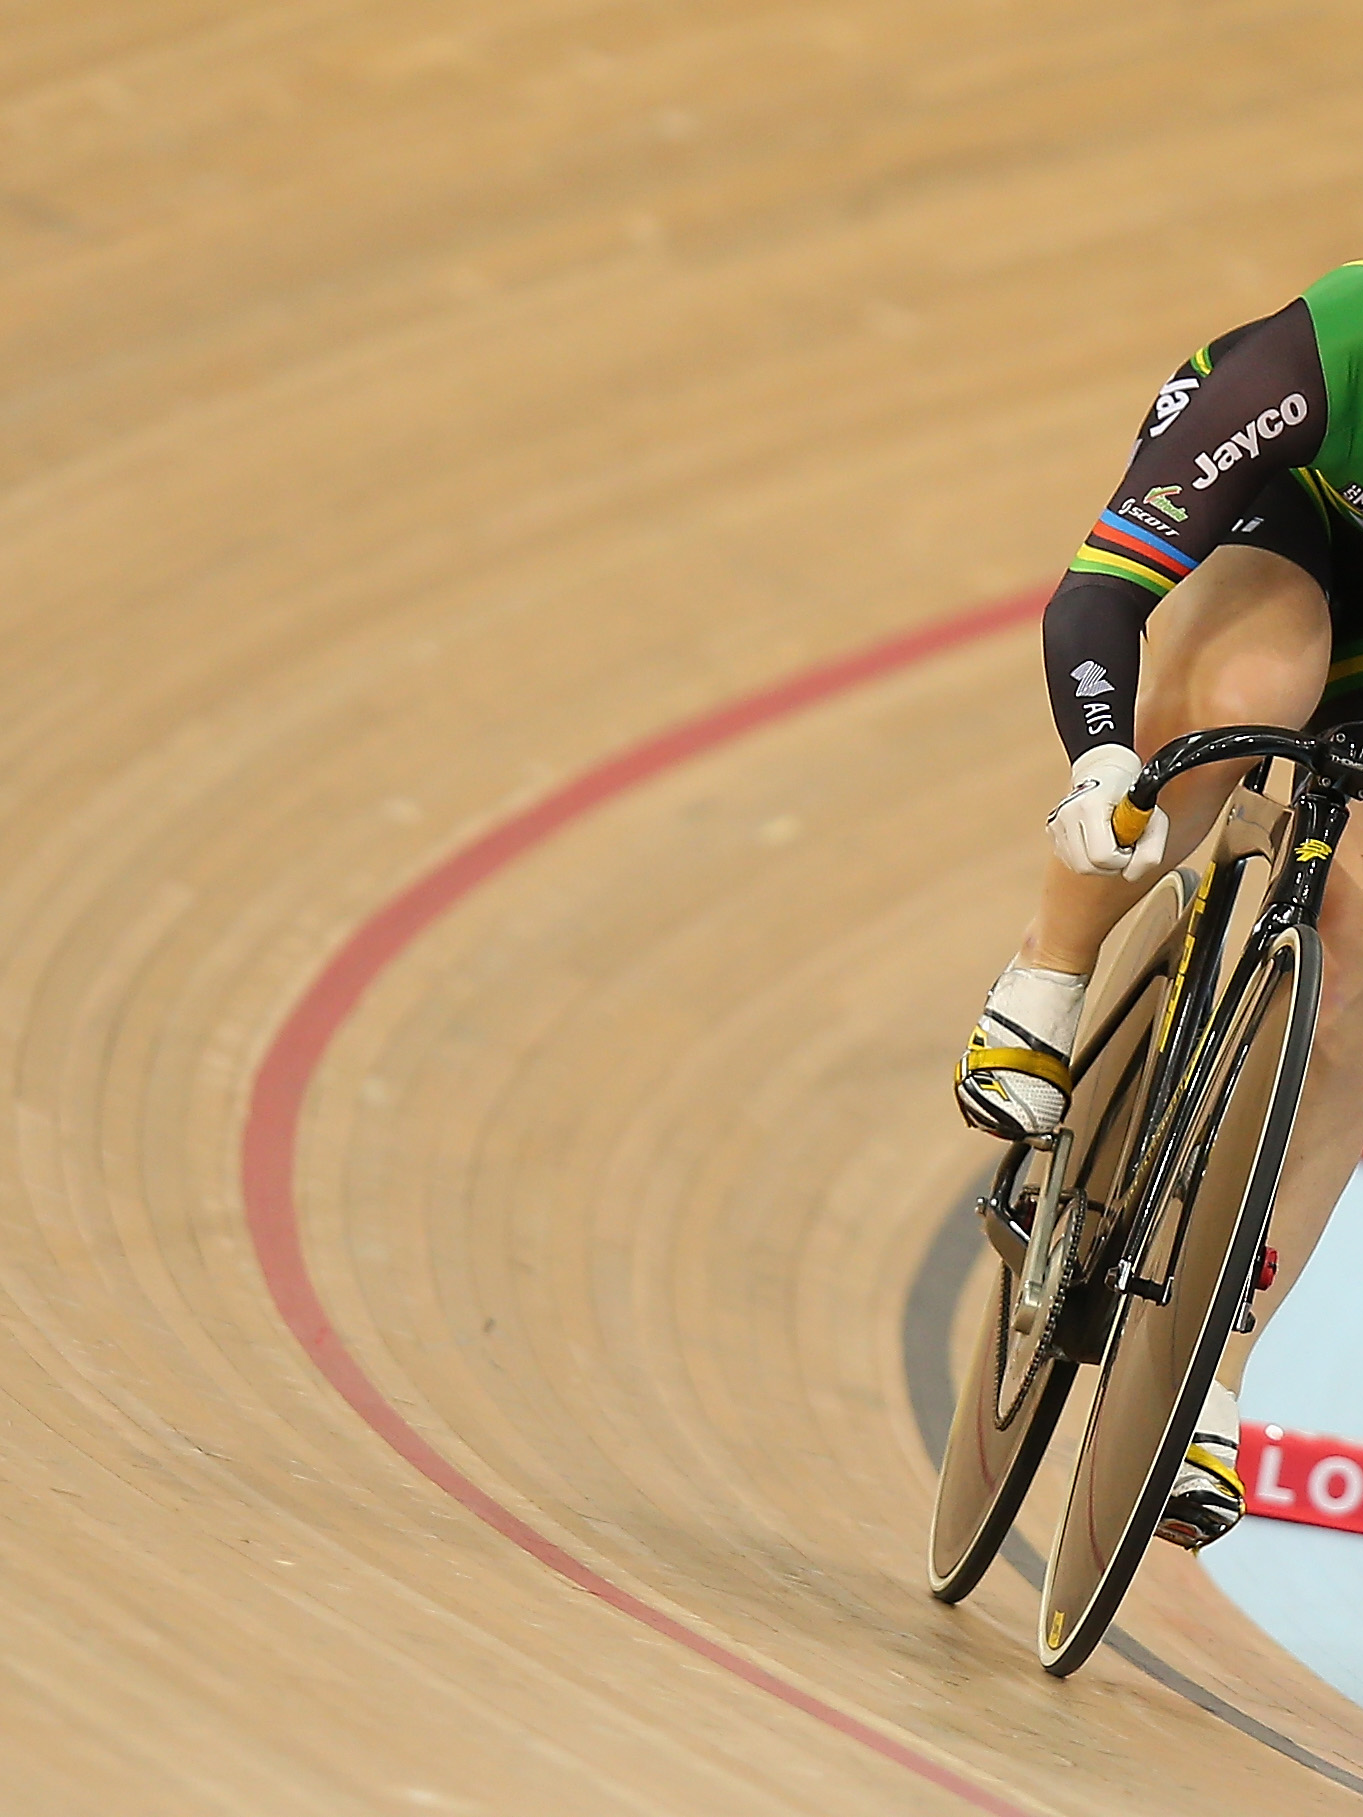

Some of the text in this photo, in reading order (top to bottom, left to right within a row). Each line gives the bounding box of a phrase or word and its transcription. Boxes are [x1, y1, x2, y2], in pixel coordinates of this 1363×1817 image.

[1192, 393, 1308, 489] Jayco
[1129, 505, 1180, 536] SCOTT
[1083, 703, 1115, 736] AIS
